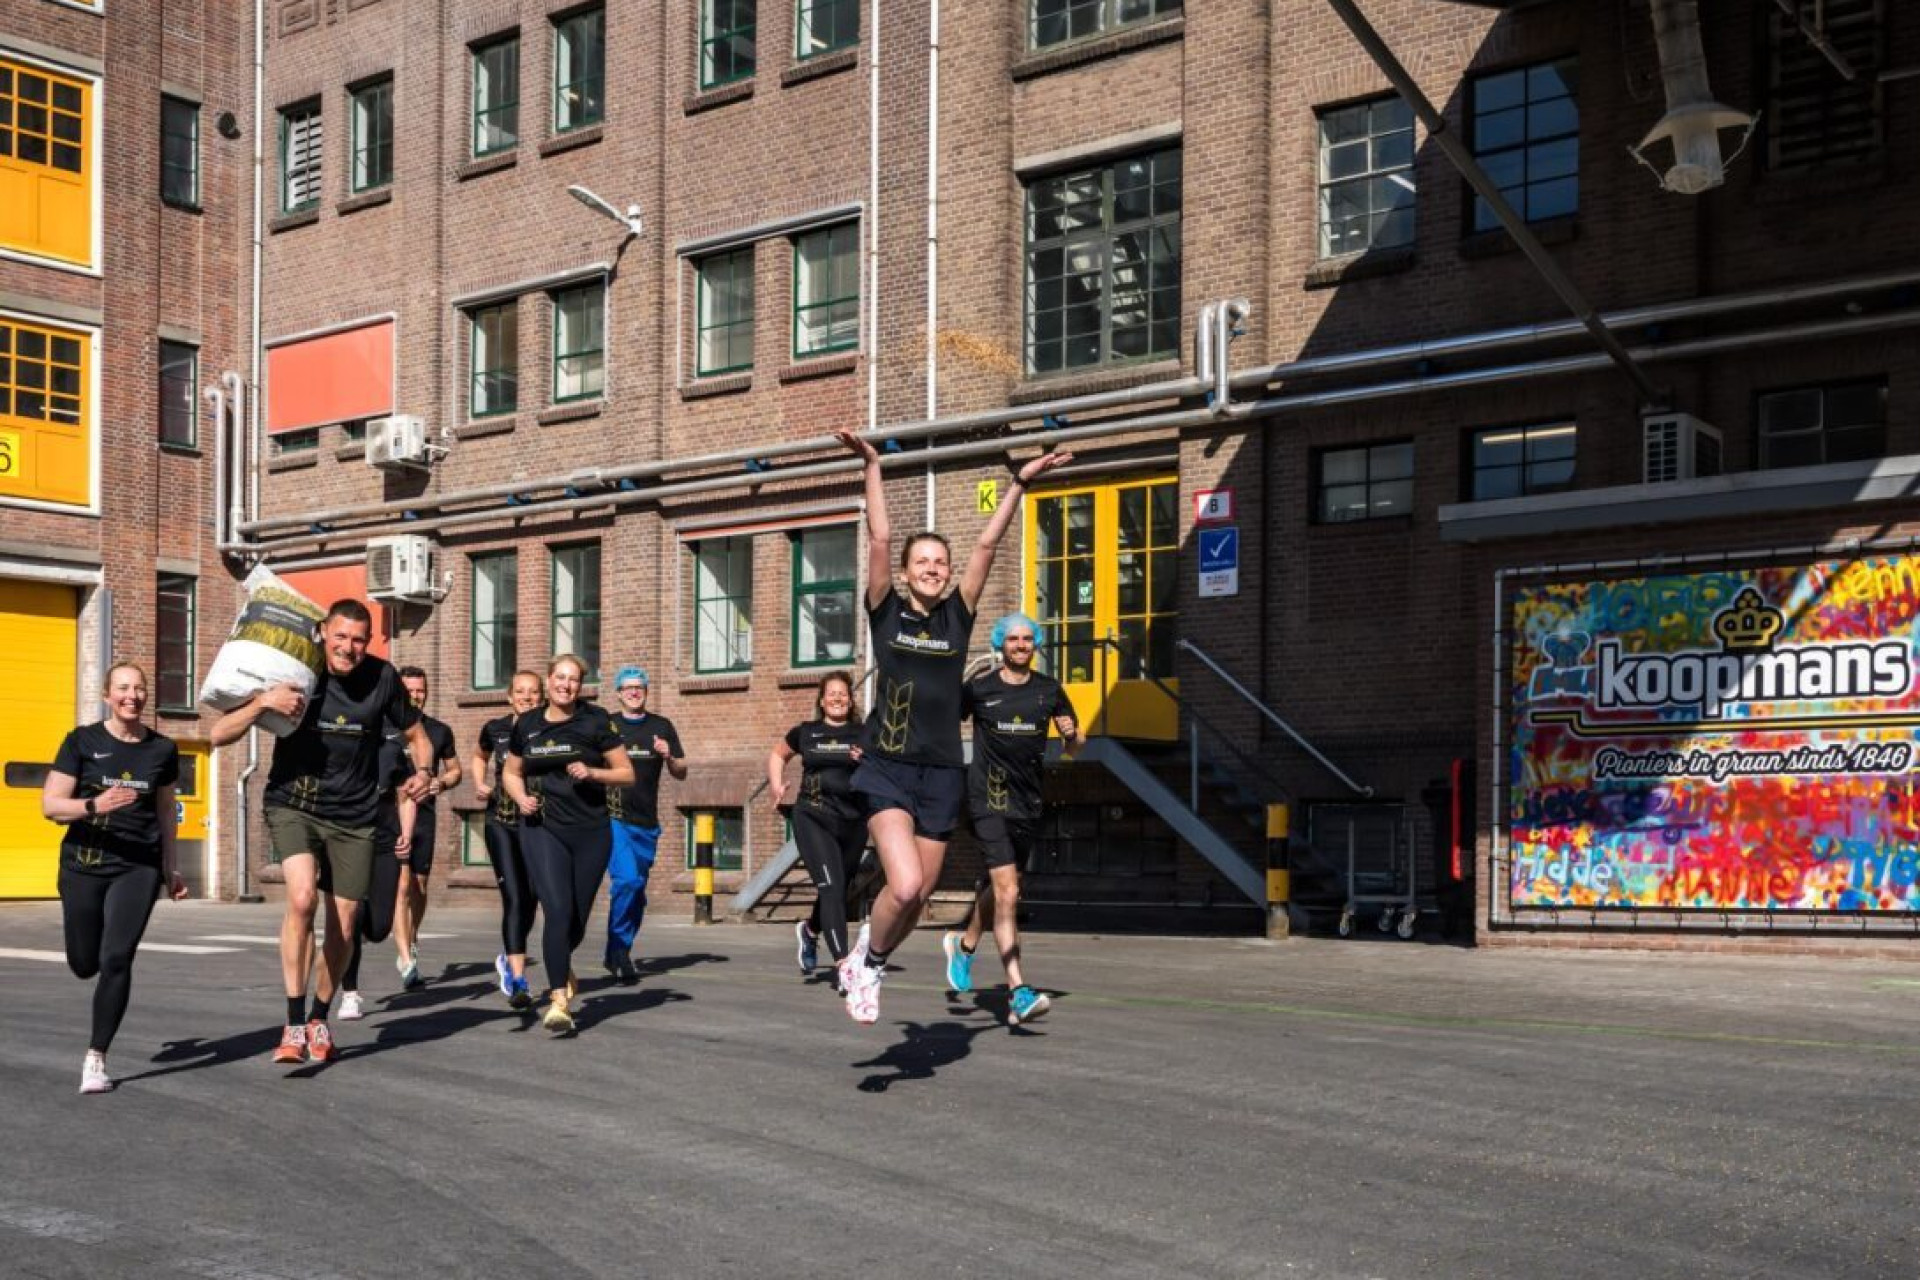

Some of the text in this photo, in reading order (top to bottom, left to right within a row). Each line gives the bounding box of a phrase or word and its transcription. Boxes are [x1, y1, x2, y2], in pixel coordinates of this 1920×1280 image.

[980, 489, 993, 509] K
[1210, 498, 1218, 513] B
[896, 631, 949, 650] koopmans
[1598, 643, 1908, 717] koopmans
[1600, 744, 1907, 779] Pioniers in graan sinds 1846
